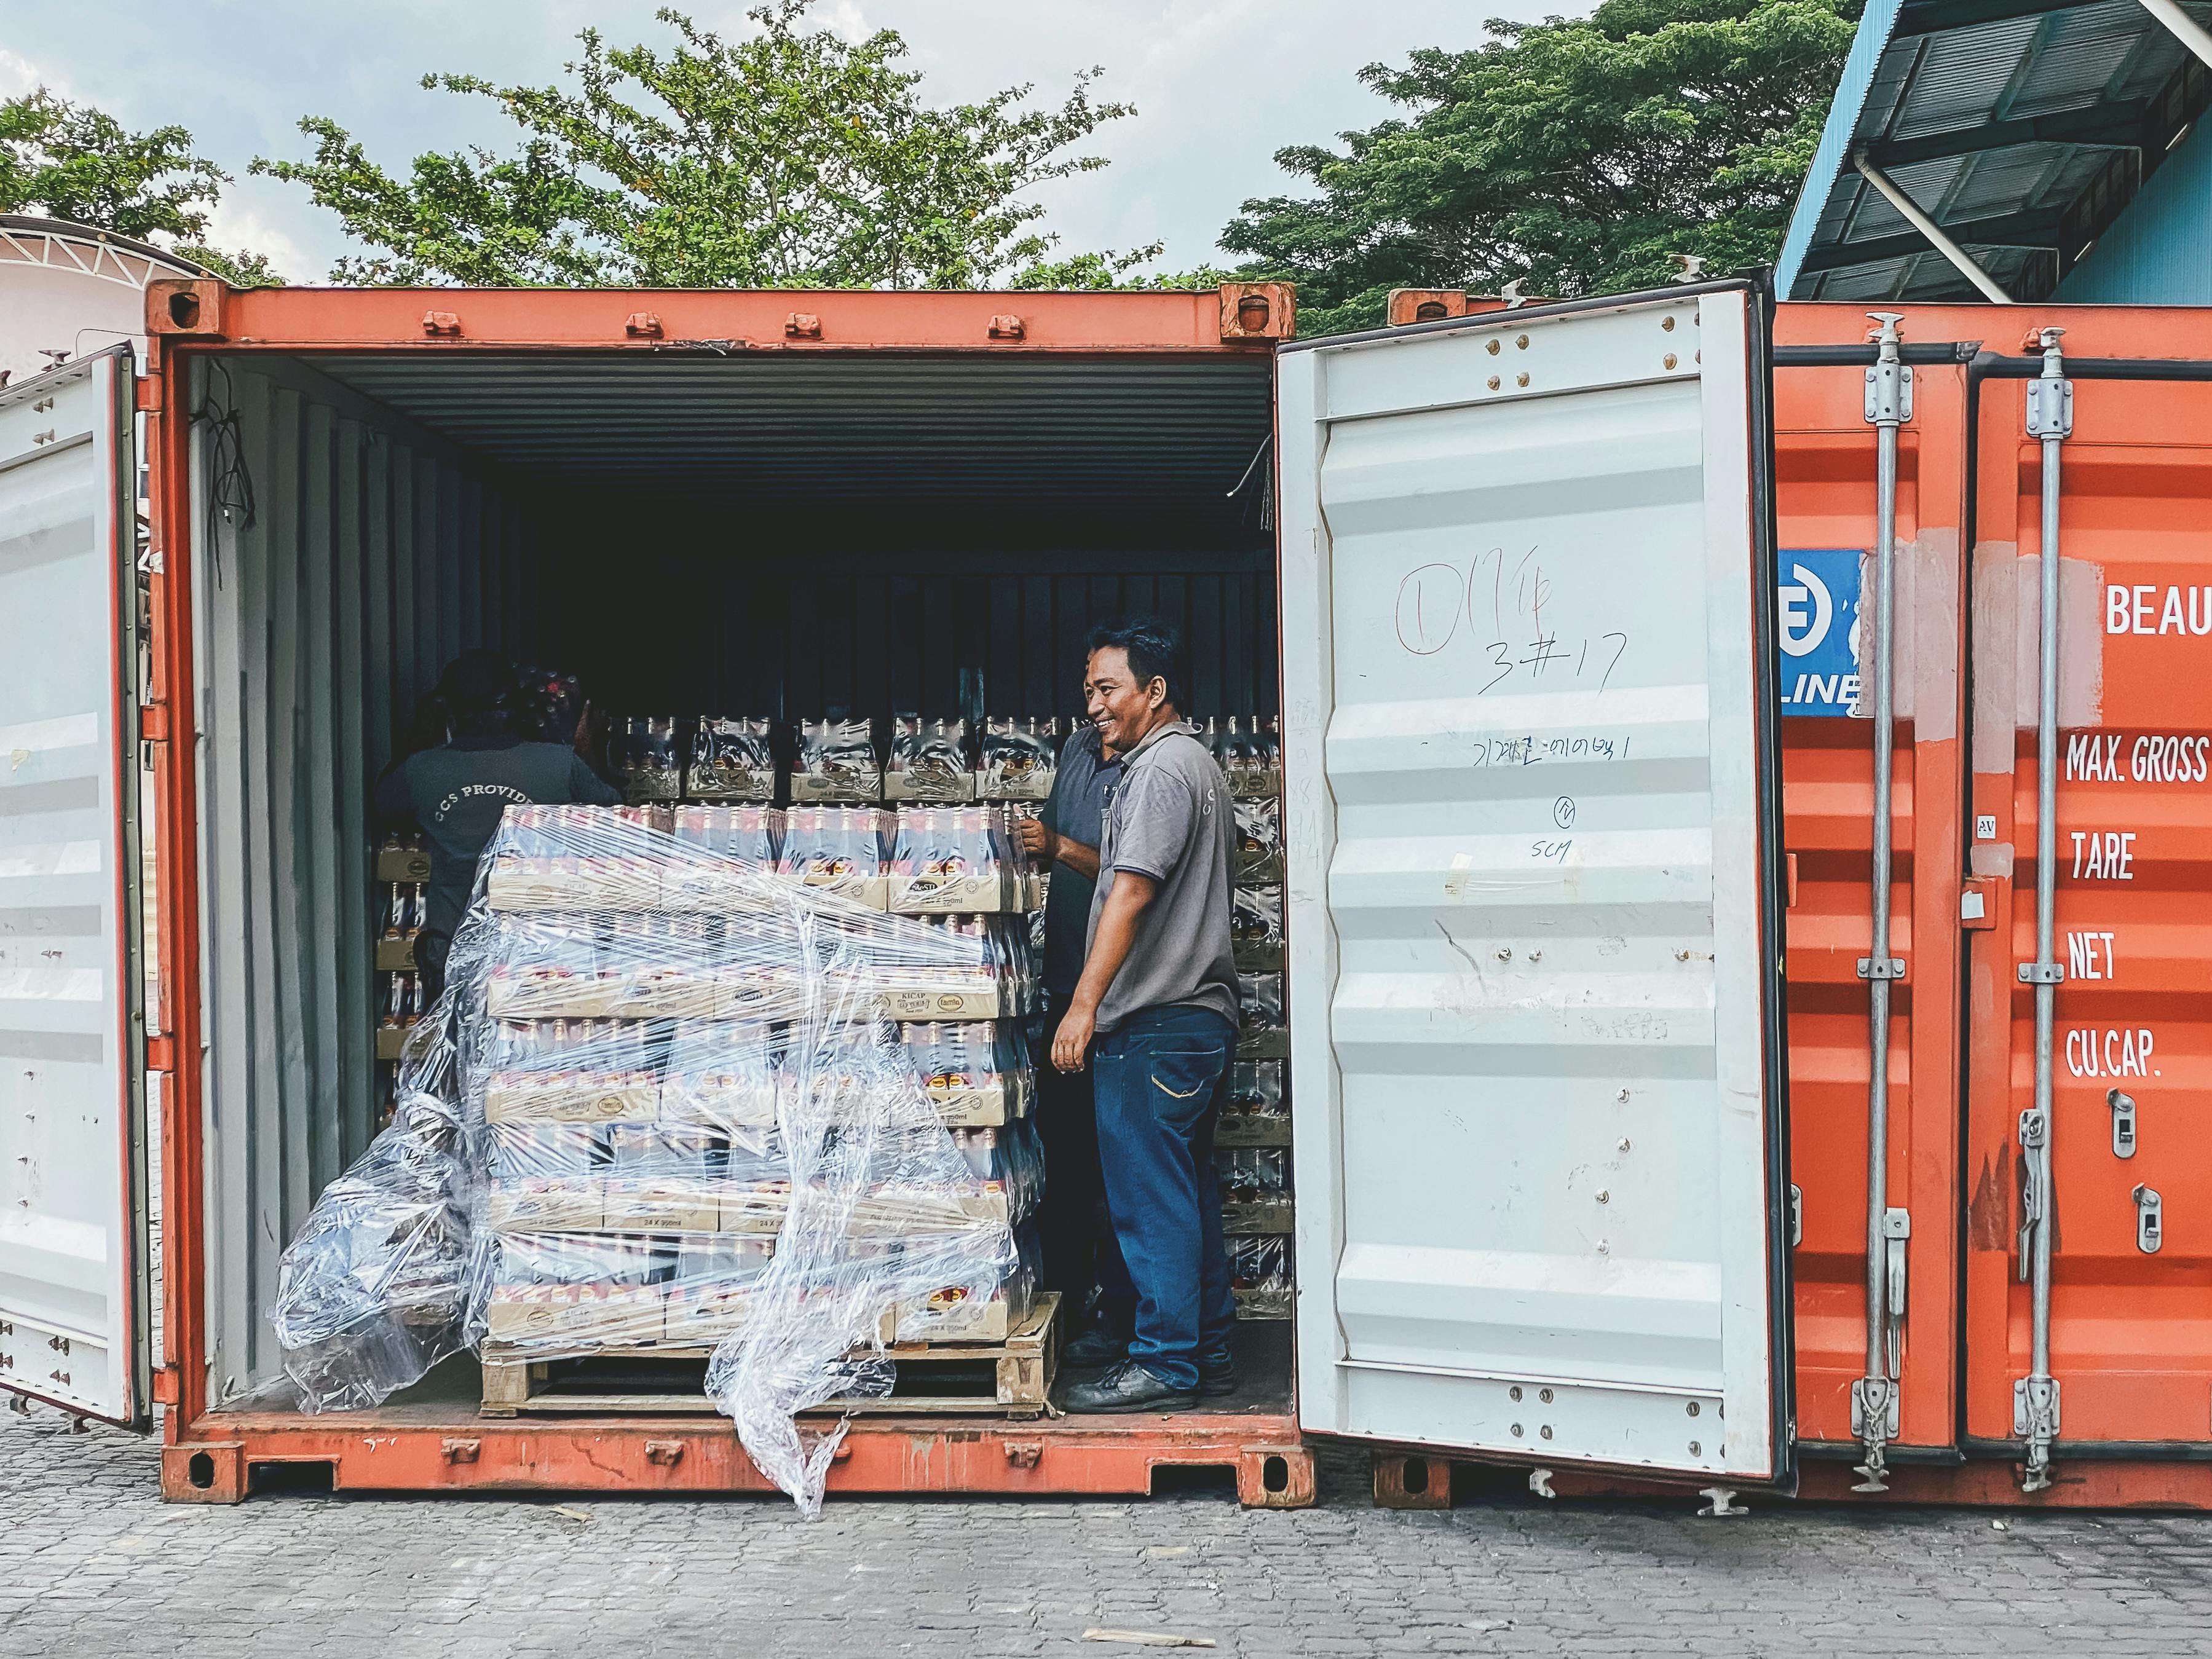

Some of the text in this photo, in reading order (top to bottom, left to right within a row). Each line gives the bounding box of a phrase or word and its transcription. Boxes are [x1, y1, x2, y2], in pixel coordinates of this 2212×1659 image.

[2066, 734, 2210, 782] MAX. GROSS
[2069, 832, 2137, 880] TARE
[2067, 932, 2115, 979] NET
[2066, 1028, 2162, 1078] CU.CAP.
